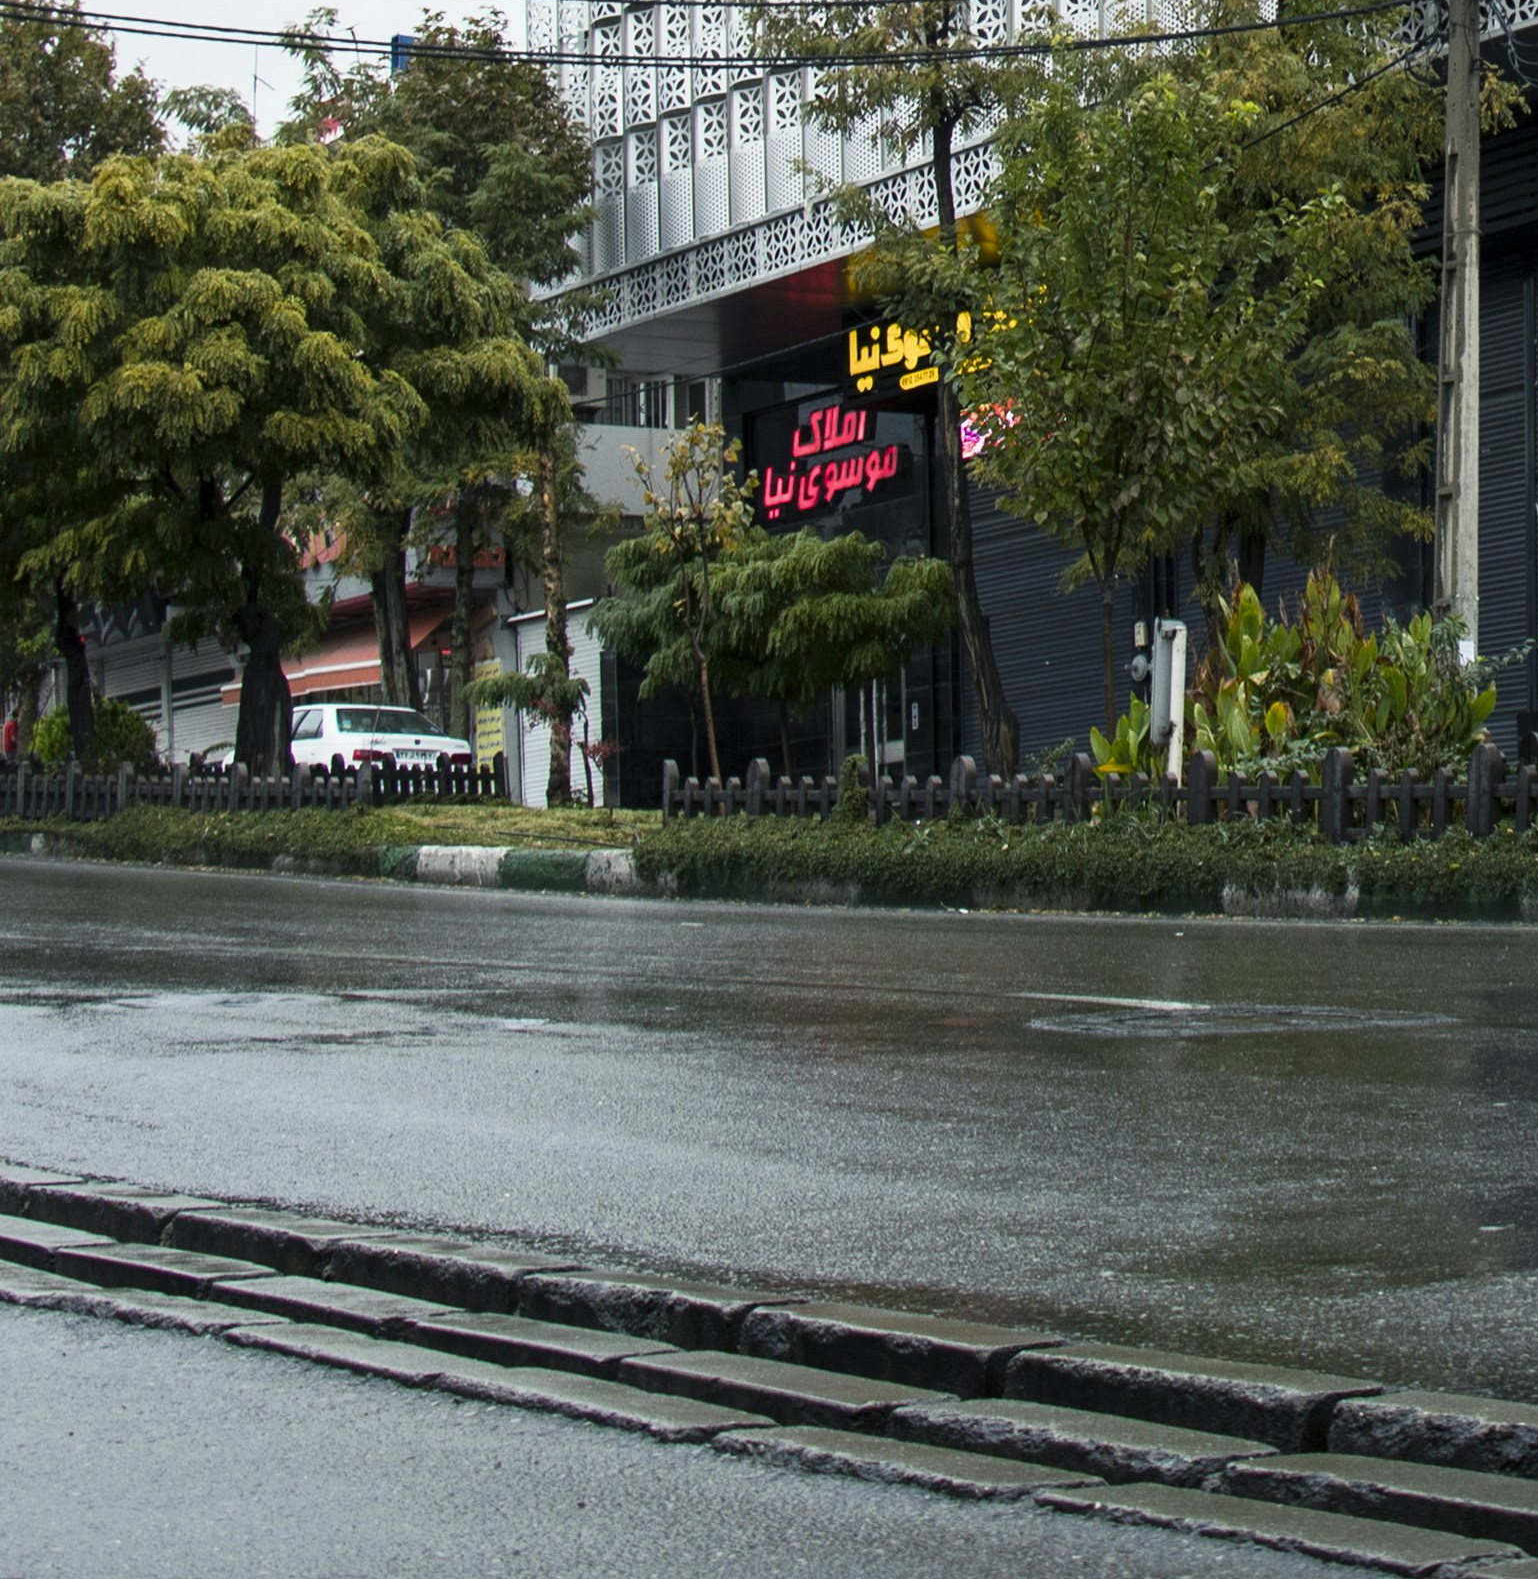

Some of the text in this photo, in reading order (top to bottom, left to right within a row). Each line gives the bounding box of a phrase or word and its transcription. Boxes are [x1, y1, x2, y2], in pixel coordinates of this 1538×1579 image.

[792, 405, 866, 458] املاک
[764, 445, 897, 519] موسوی نیا
